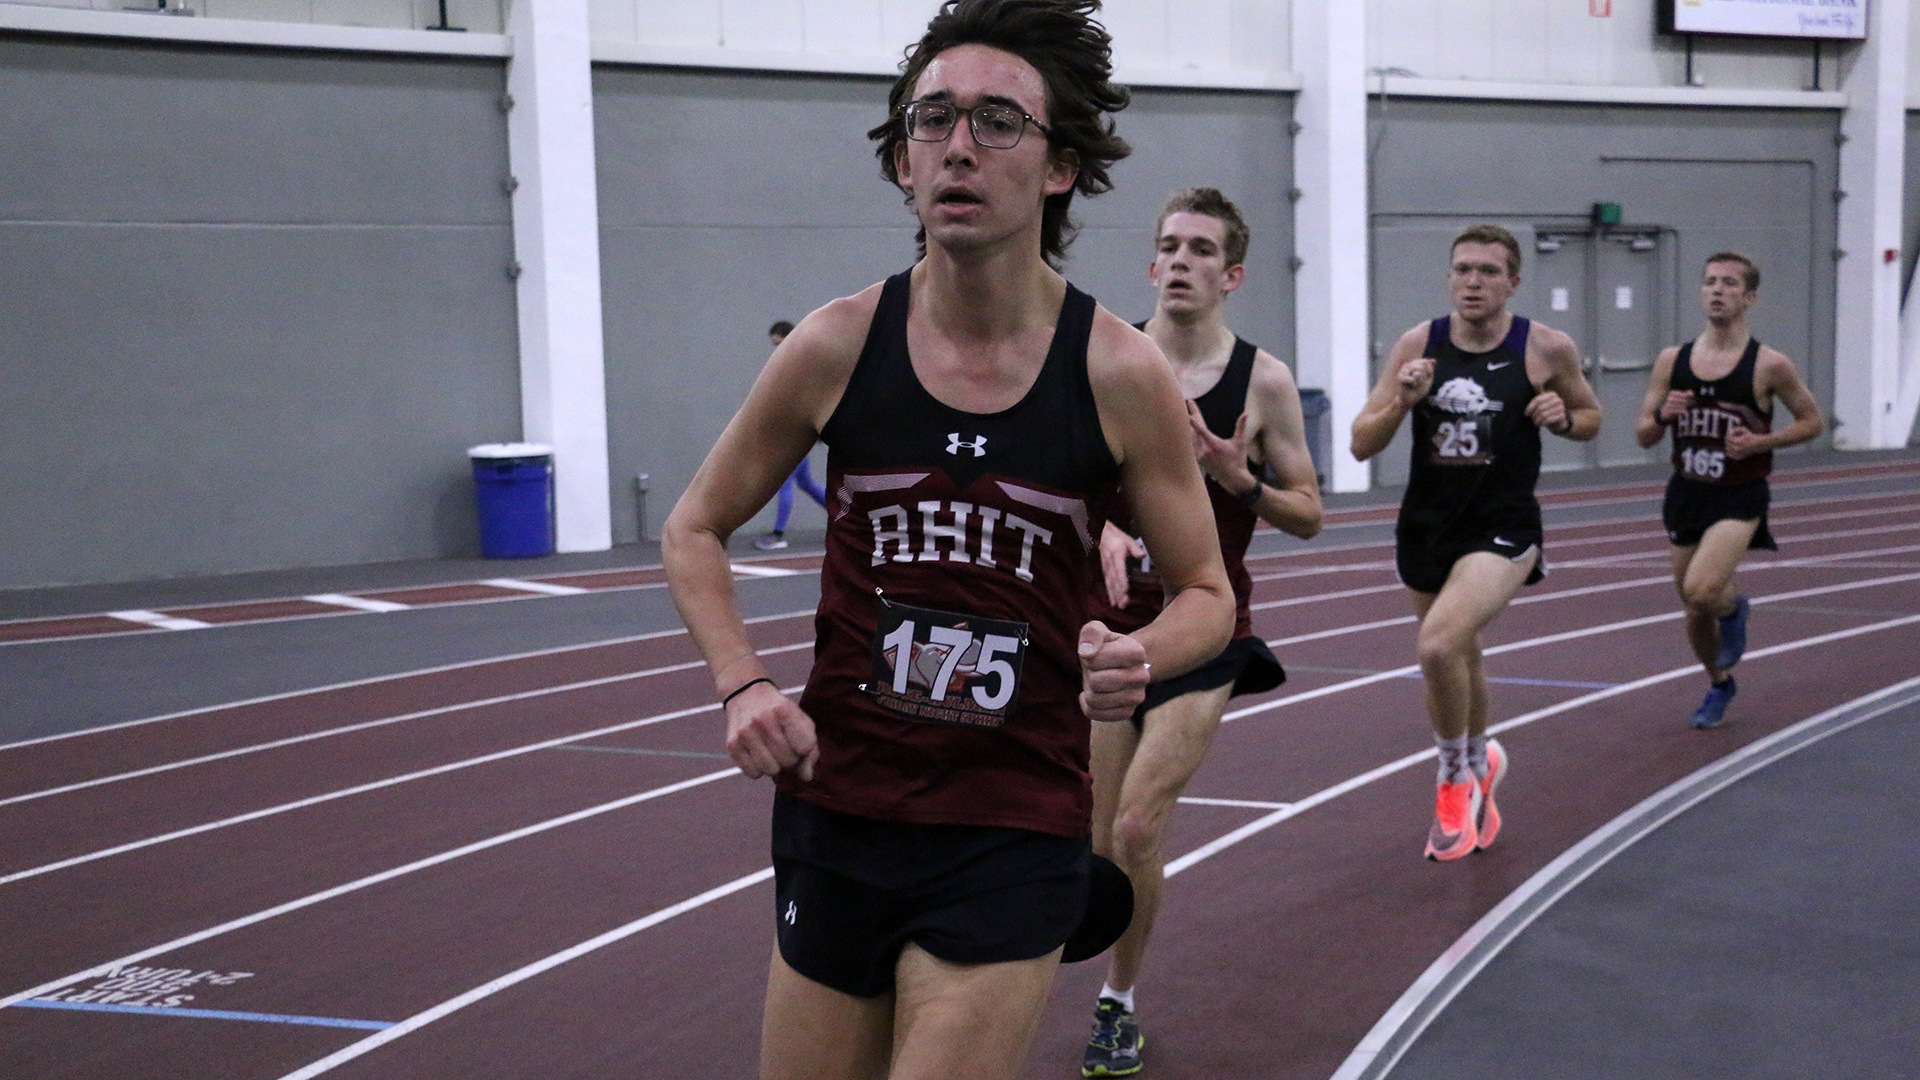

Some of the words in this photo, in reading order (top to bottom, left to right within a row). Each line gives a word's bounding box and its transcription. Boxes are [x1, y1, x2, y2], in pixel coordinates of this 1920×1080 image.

[1437, 421, 1479, 457] 25
[1681, 446, 1725, 478] 165
[867, 500, 1053, 582] RHIT
[882, 619, 1019, 710] 175
